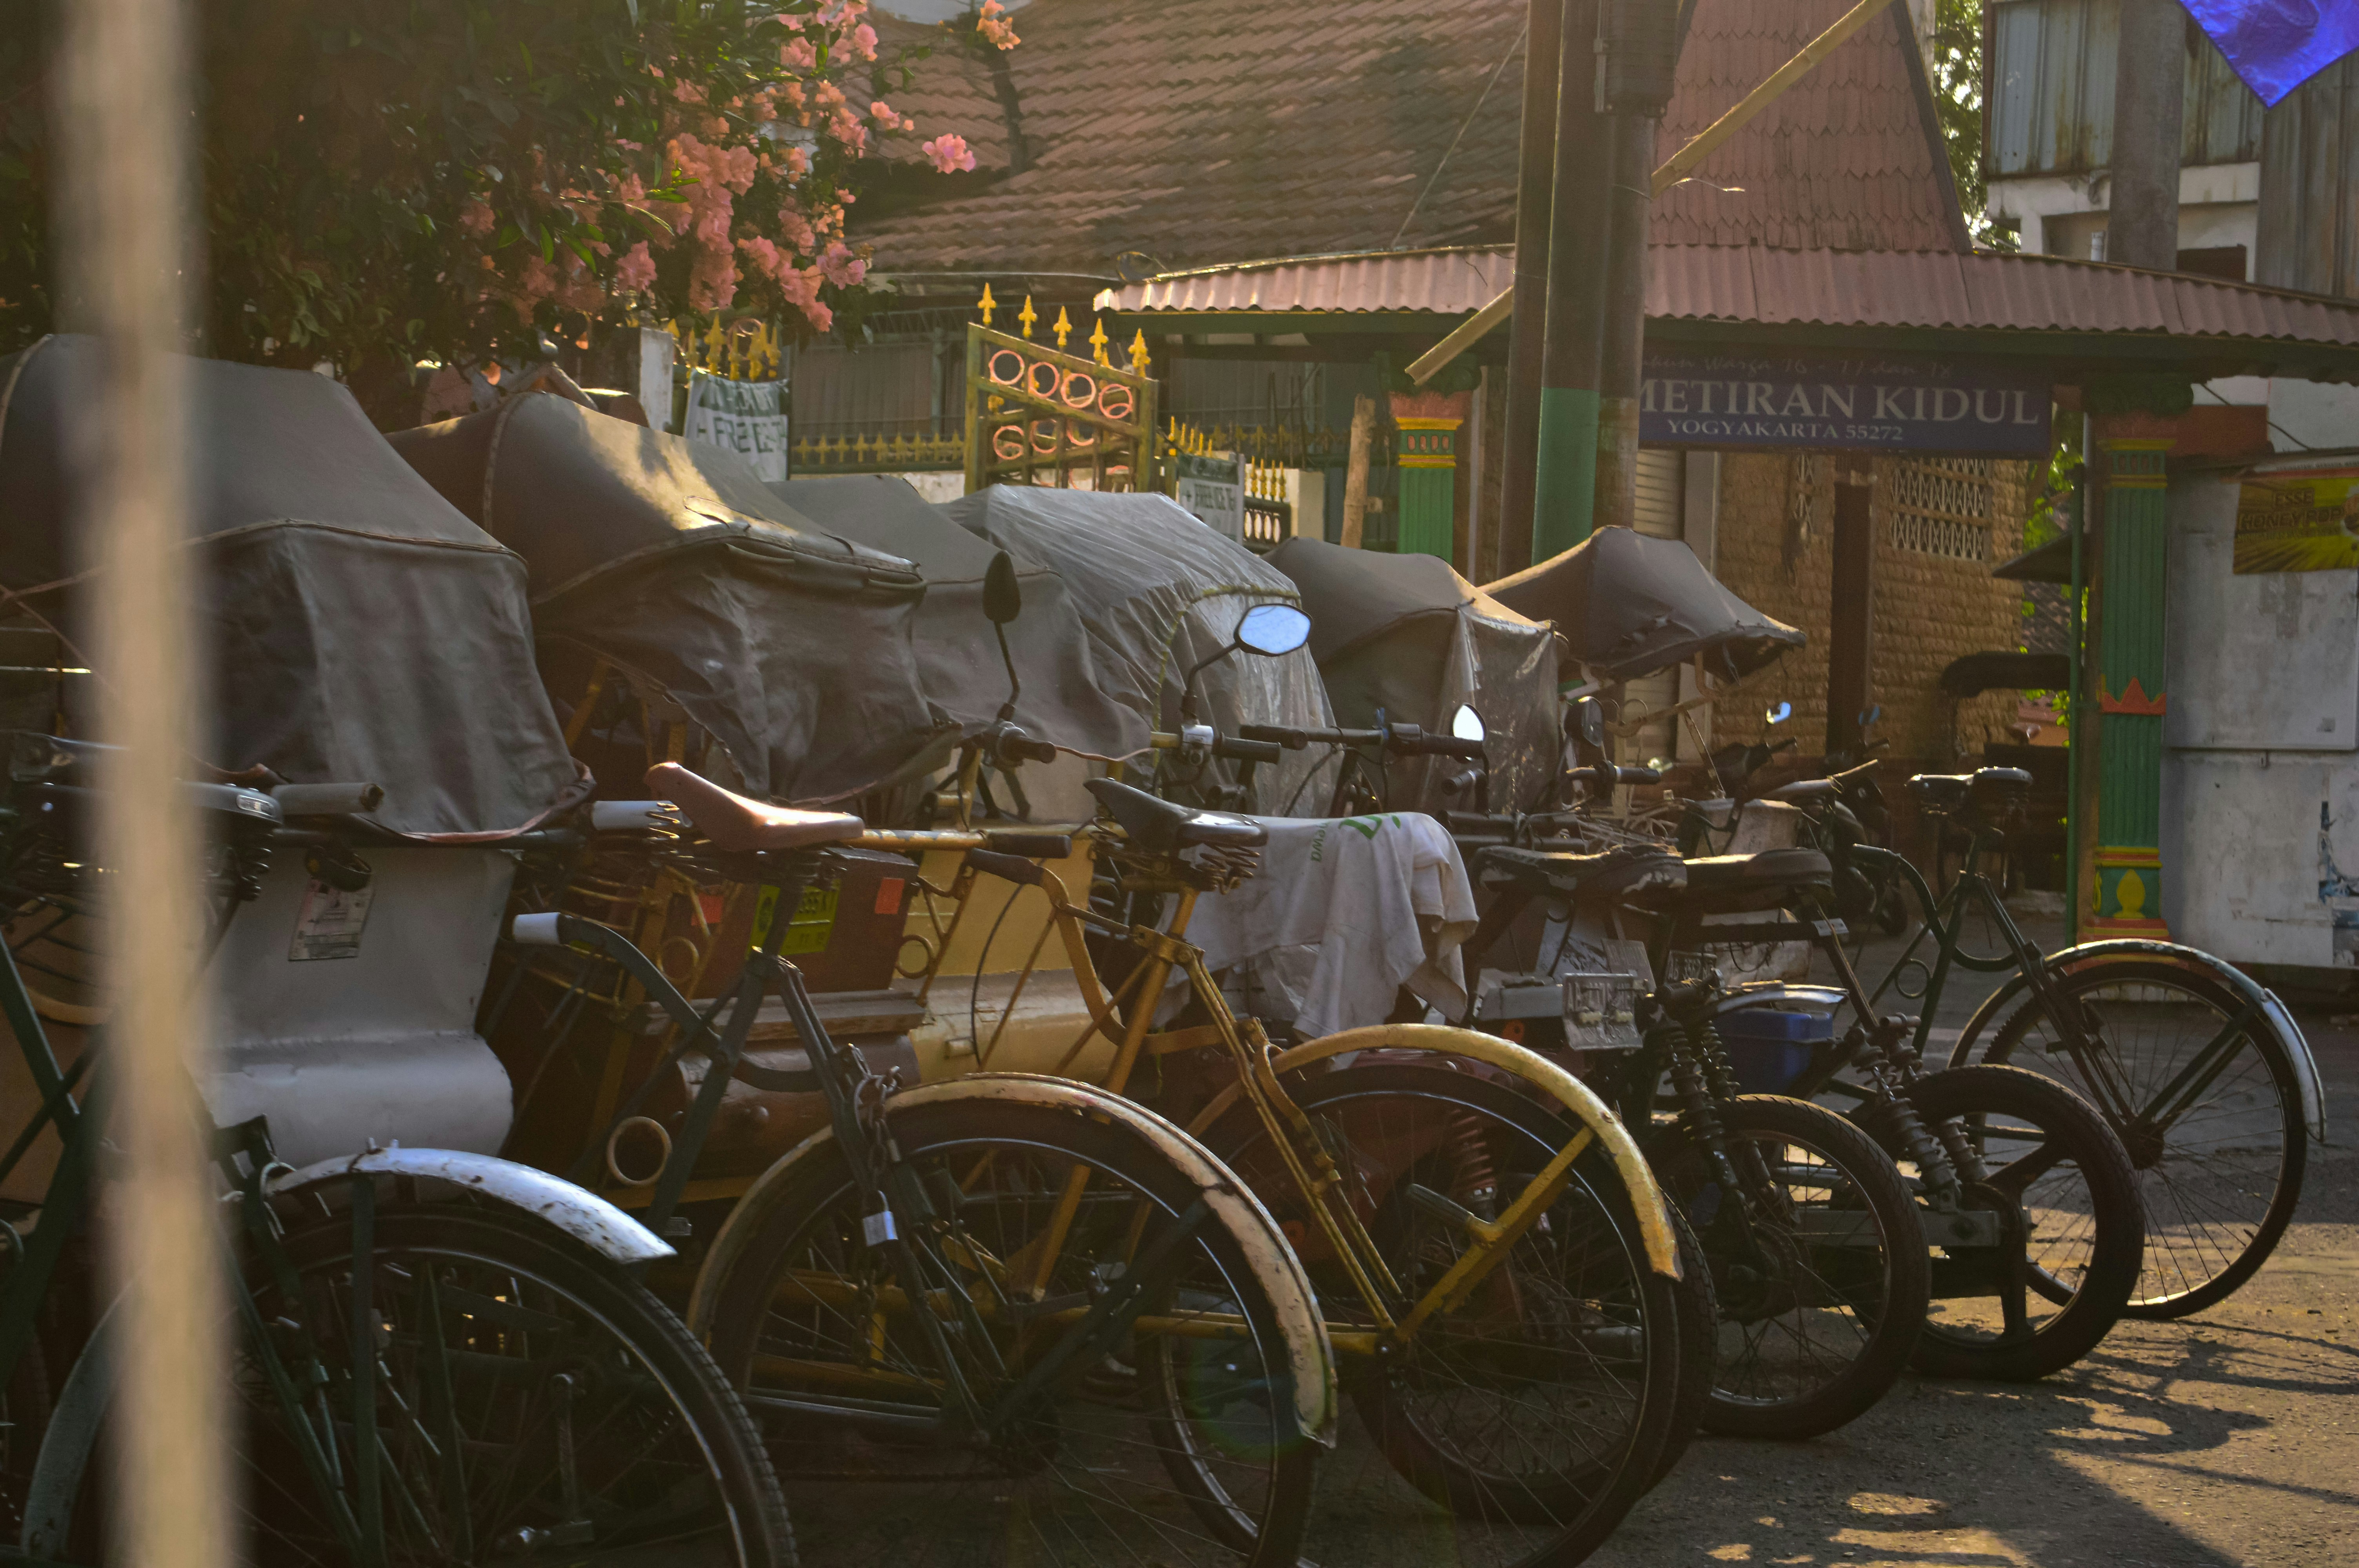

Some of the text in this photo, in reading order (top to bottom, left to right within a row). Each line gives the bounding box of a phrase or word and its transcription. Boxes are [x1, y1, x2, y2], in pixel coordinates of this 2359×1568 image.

[1873, 386, 2038, 424] KIDUL
[1667, 419, 1903, 440] YOGYAKARTA 55272
[2274, 490, 2314, 507] ESSE
[2238, 507, 2344, 530] HONEY POP
